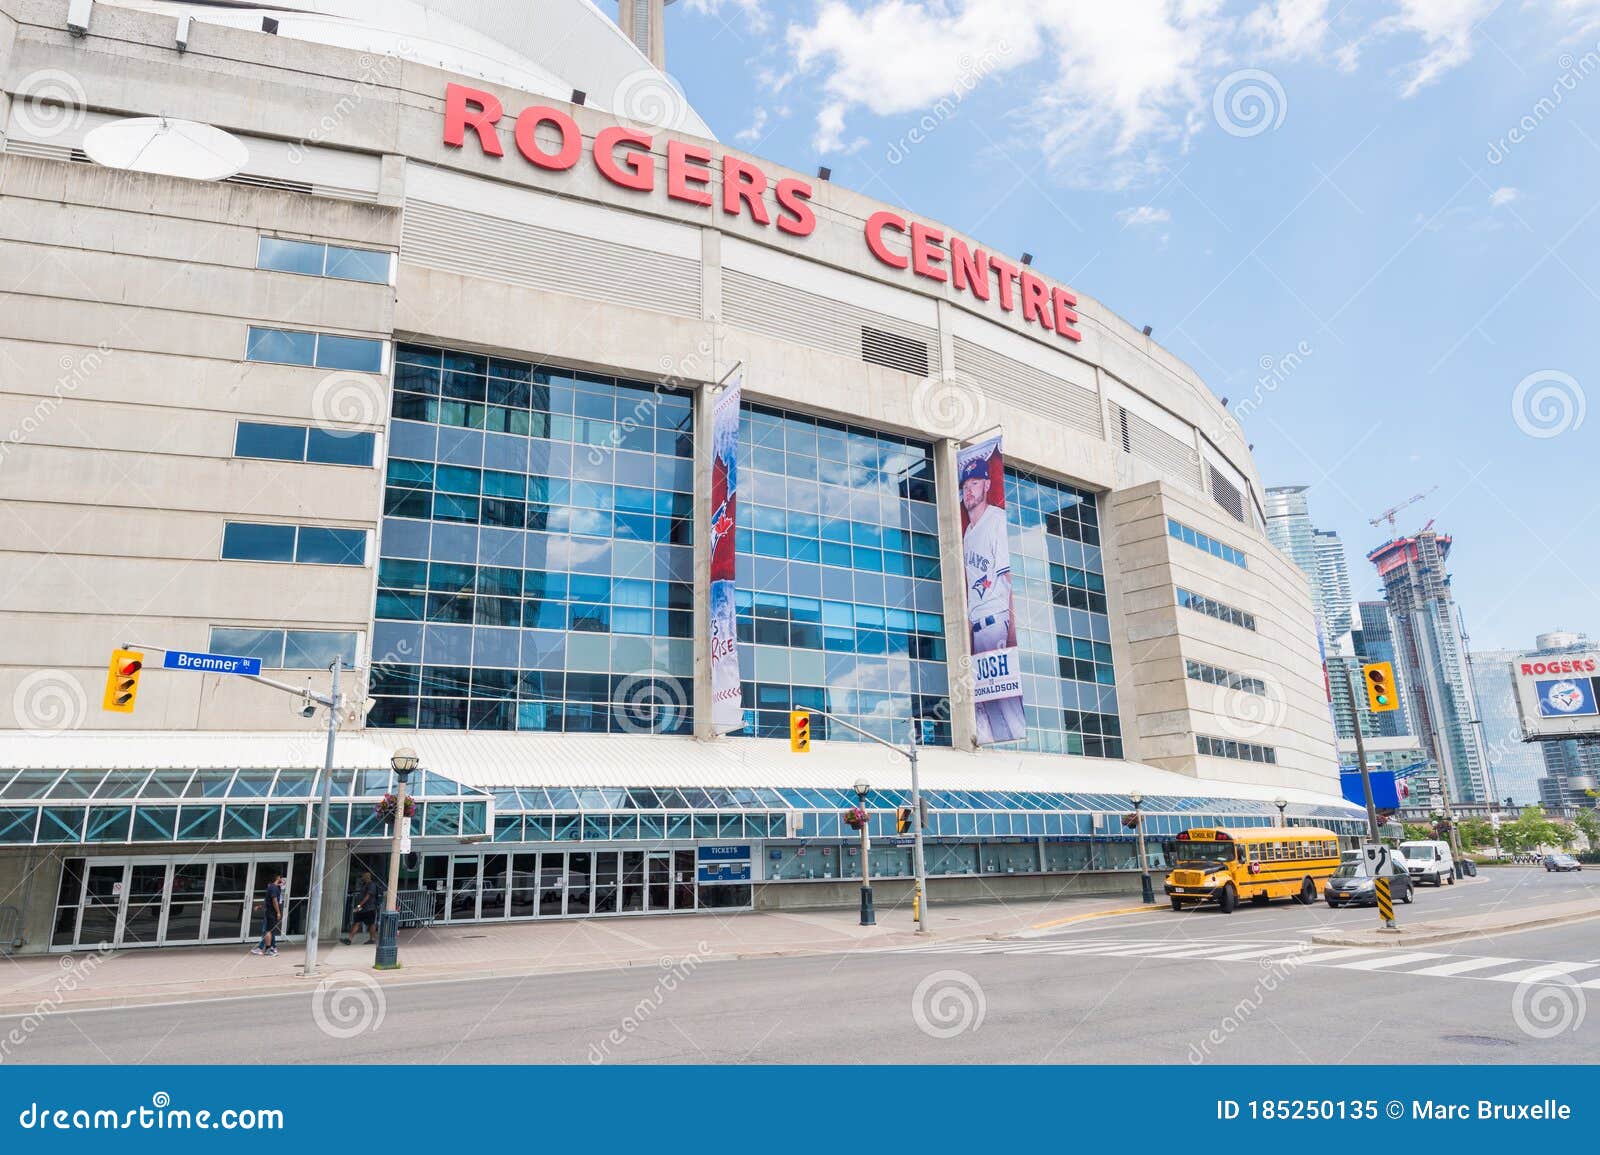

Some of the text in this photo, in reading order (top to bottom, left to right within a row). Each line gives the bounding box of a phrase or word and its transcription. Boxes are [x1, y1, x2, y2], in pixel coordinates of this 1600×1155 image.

[443, 82, 1082, 342] ROGERS CENTRE
[177, 654, 238, 671] Bremner
[977, 654, 1009, 681] JOSH
[1521, 658, 1596, 675] ROGERS
[974, 681, 1019, 697] DONALDSON
